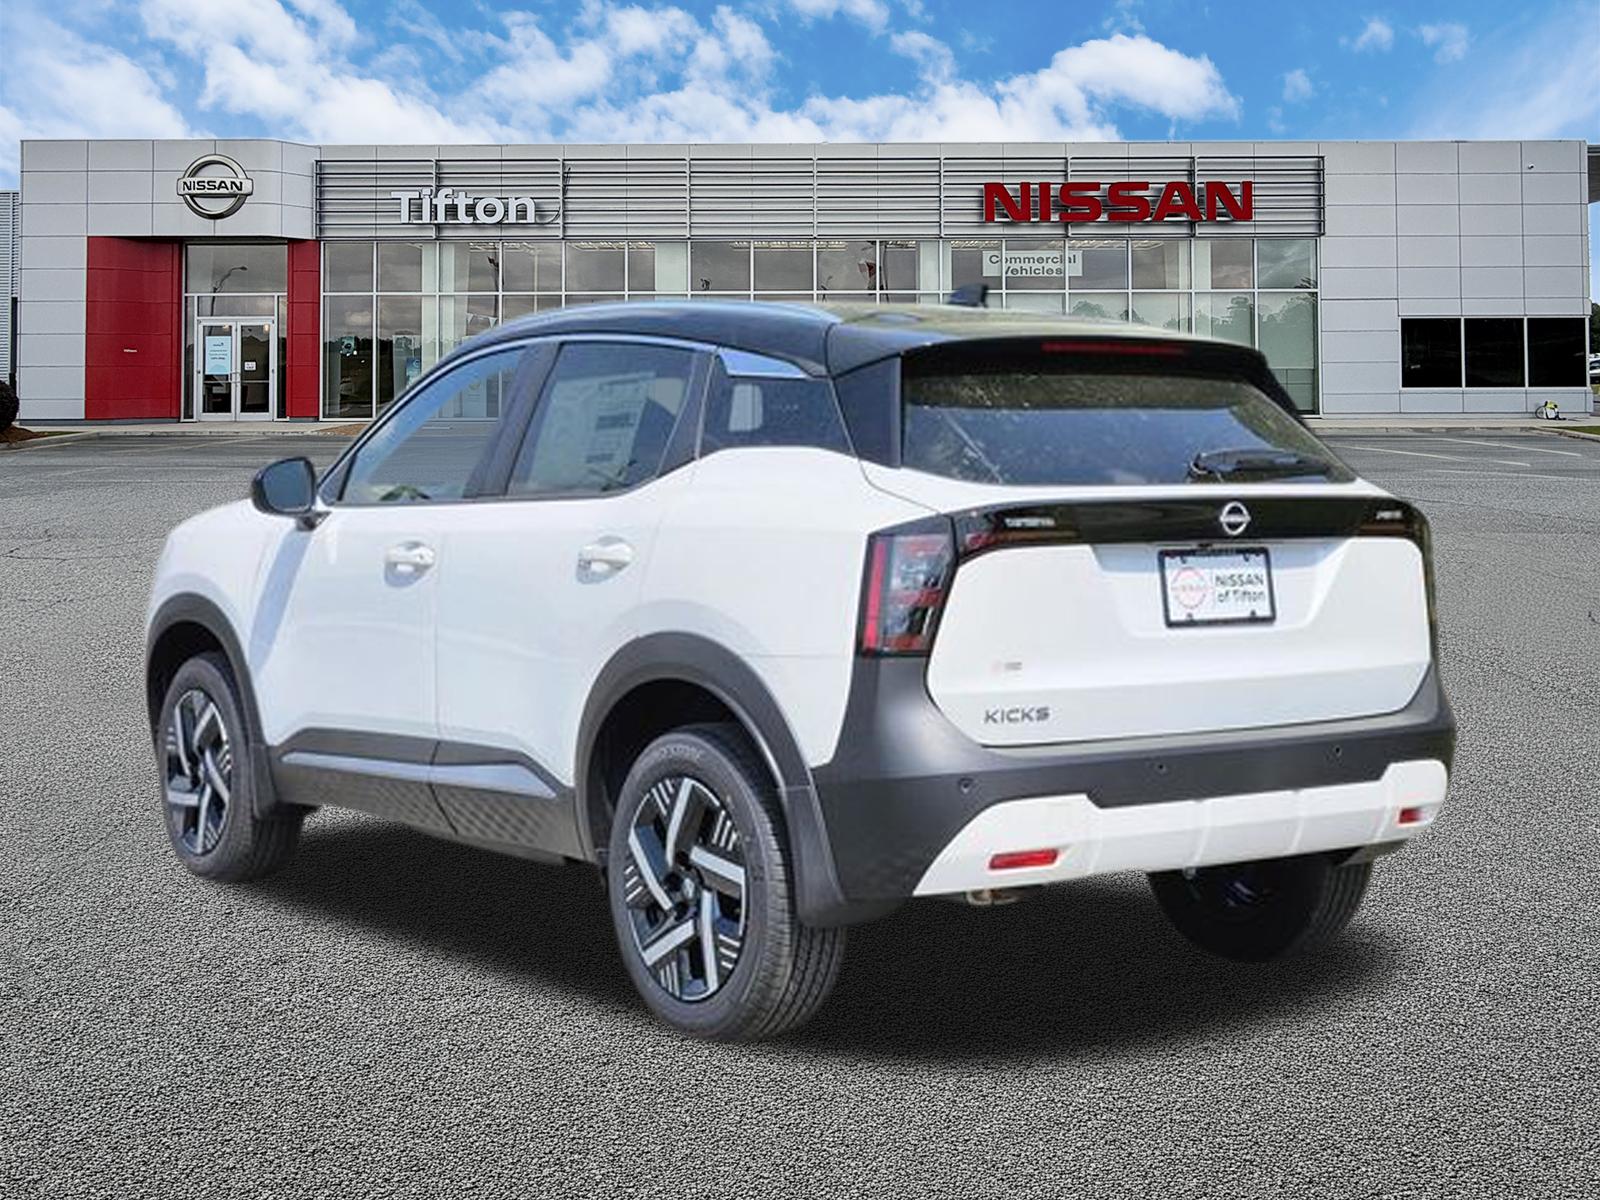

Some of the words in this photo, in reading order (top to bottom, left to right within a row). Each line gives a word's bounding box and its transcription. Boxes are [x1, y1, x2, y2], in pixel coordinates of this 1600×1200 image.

[182, 180, 243, 191] NISSAN
[391, 188, 536, 224] Tifton
[983, 180, 1254, 223] NISSAN
[1215, 573, 1264, 587] NISSAN
[984, 707, 1050, 724] KICKS
